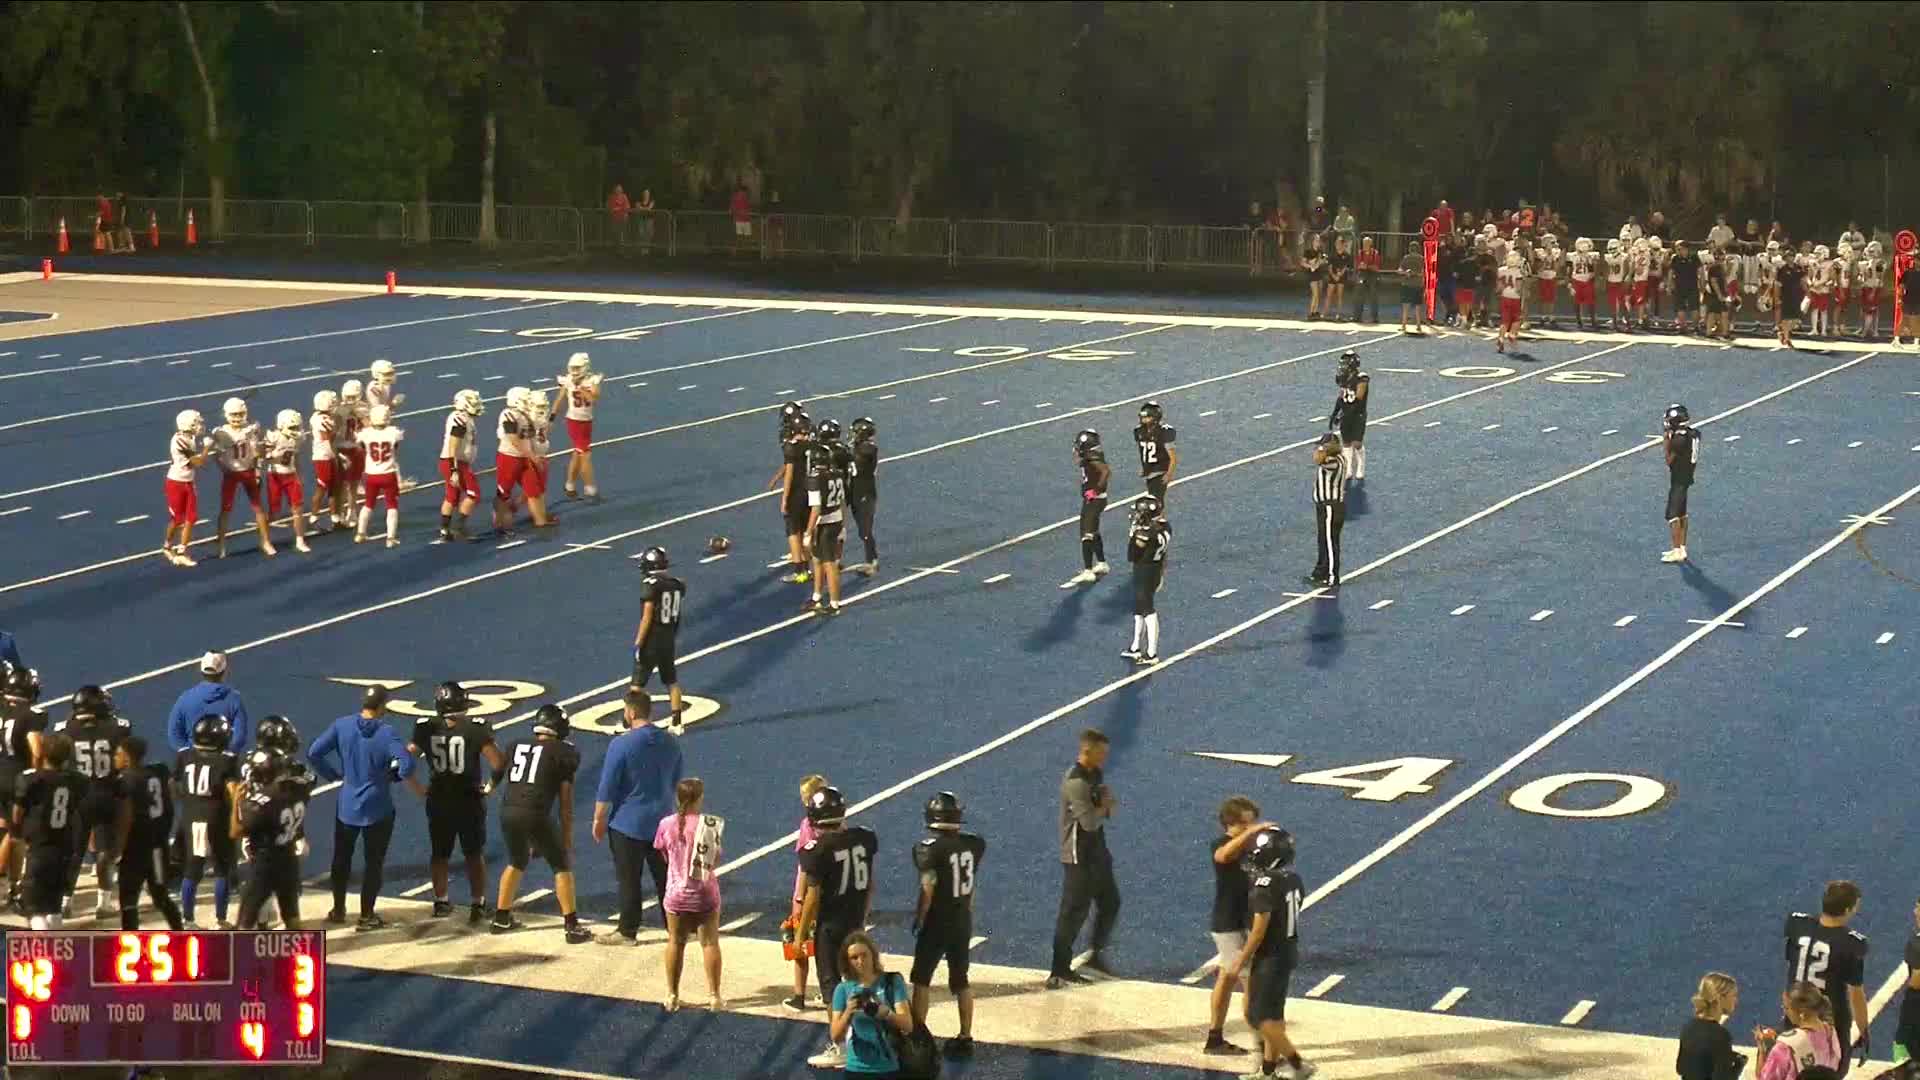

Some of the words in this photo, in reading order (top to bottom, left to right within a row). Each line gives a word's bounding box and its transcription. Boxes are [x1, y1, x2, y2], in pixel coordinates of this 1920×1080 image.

[370, 441, 391, 462] 62
[1139, 441, 1158, 463] 72
[661, 590, 681, 624] 84
[74, 739, 111, 779] 56
[430, 735, 465, 775] 50
[509, 743, 544, 784] 51
[1290, 756, 1666, 817] 40
[50, 786, 69, 829] 8
[833, 844, 869, 896] 76
[949, 850, 974, 898] 13
[1795, 935, 1830, 990] 12
